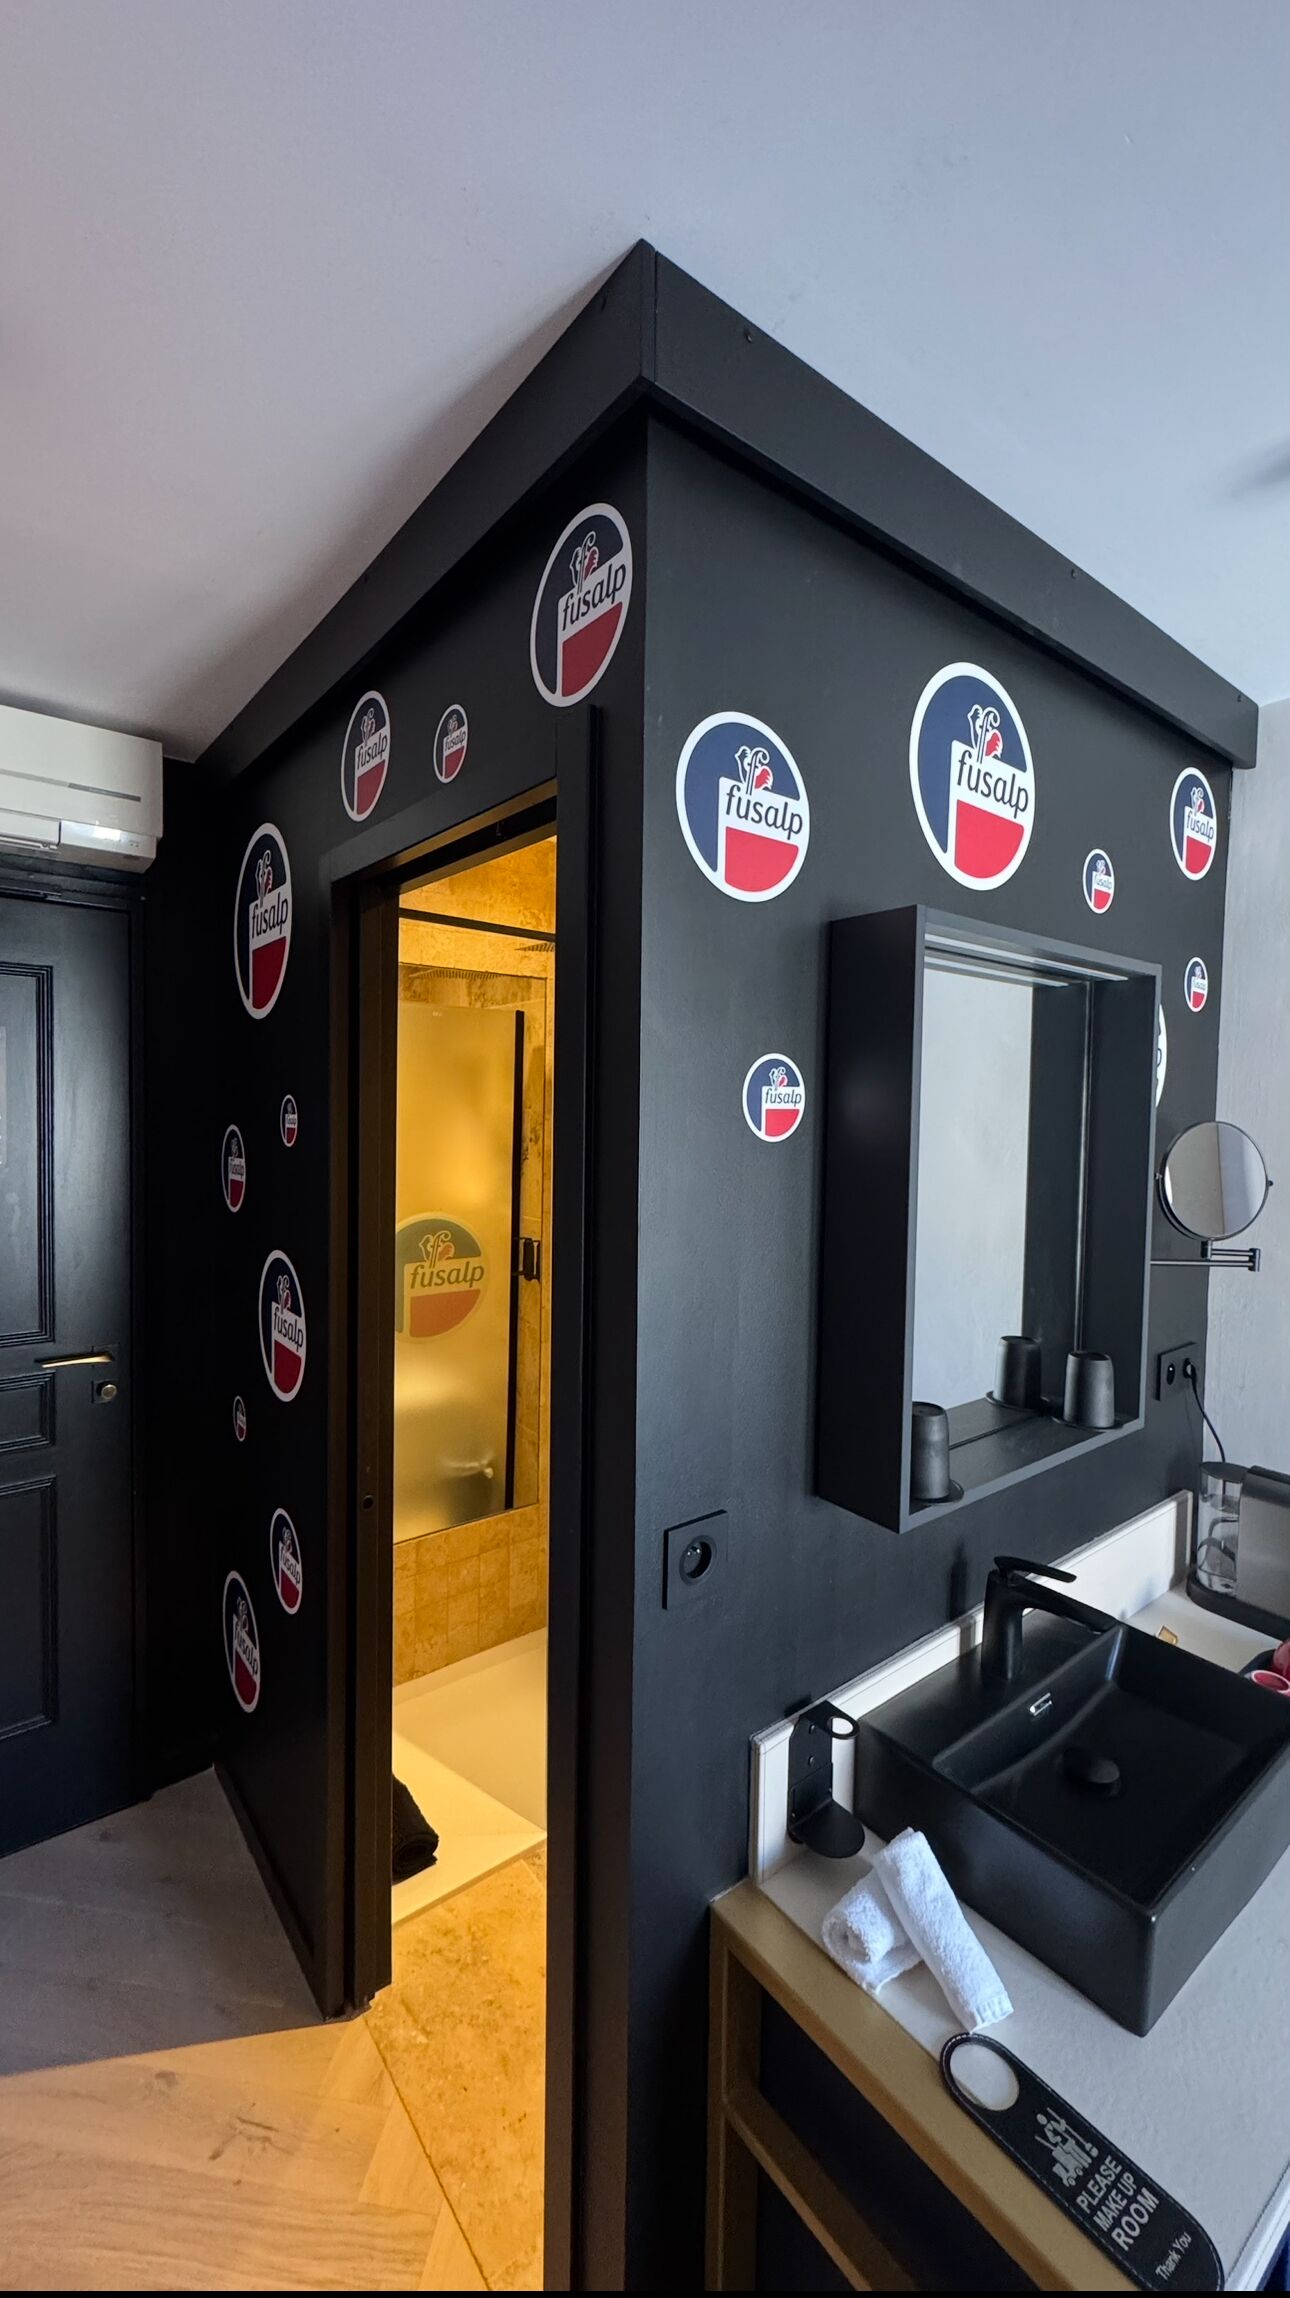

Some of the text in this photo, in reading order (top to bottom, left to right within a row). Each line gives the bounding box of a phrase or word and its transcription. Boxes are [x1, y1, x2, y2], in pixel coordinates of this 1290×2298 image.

[562, 563, 625, 632] fusalp
[356, 735, 388, 771] fusalp
[445, 731, 466, 752] fusalp
[957, 751, 1029, 819] fusalp
[725, 785, 803, 840] fusalp
[1187, 811, 1214, 842] fusalp
[251, 899, 288, 940] fusalp
[765, 1087, 802, 1107] fusalp
[410, 1263, 485, 1289] fusalp
[273, 1309, 304, 1352] fusalp
[280, 1550, 301, 1585] fusalp
[234, 1628, 259, 1676] fusalp
[1076, 2156, 1122, 2213] PLEASE
[1093, 2173, 1137, 2232] MAKE UP
[1111, 2188, 1160, 2250] ROOM
[1156, 2232, 1192, 2280] Thank You
